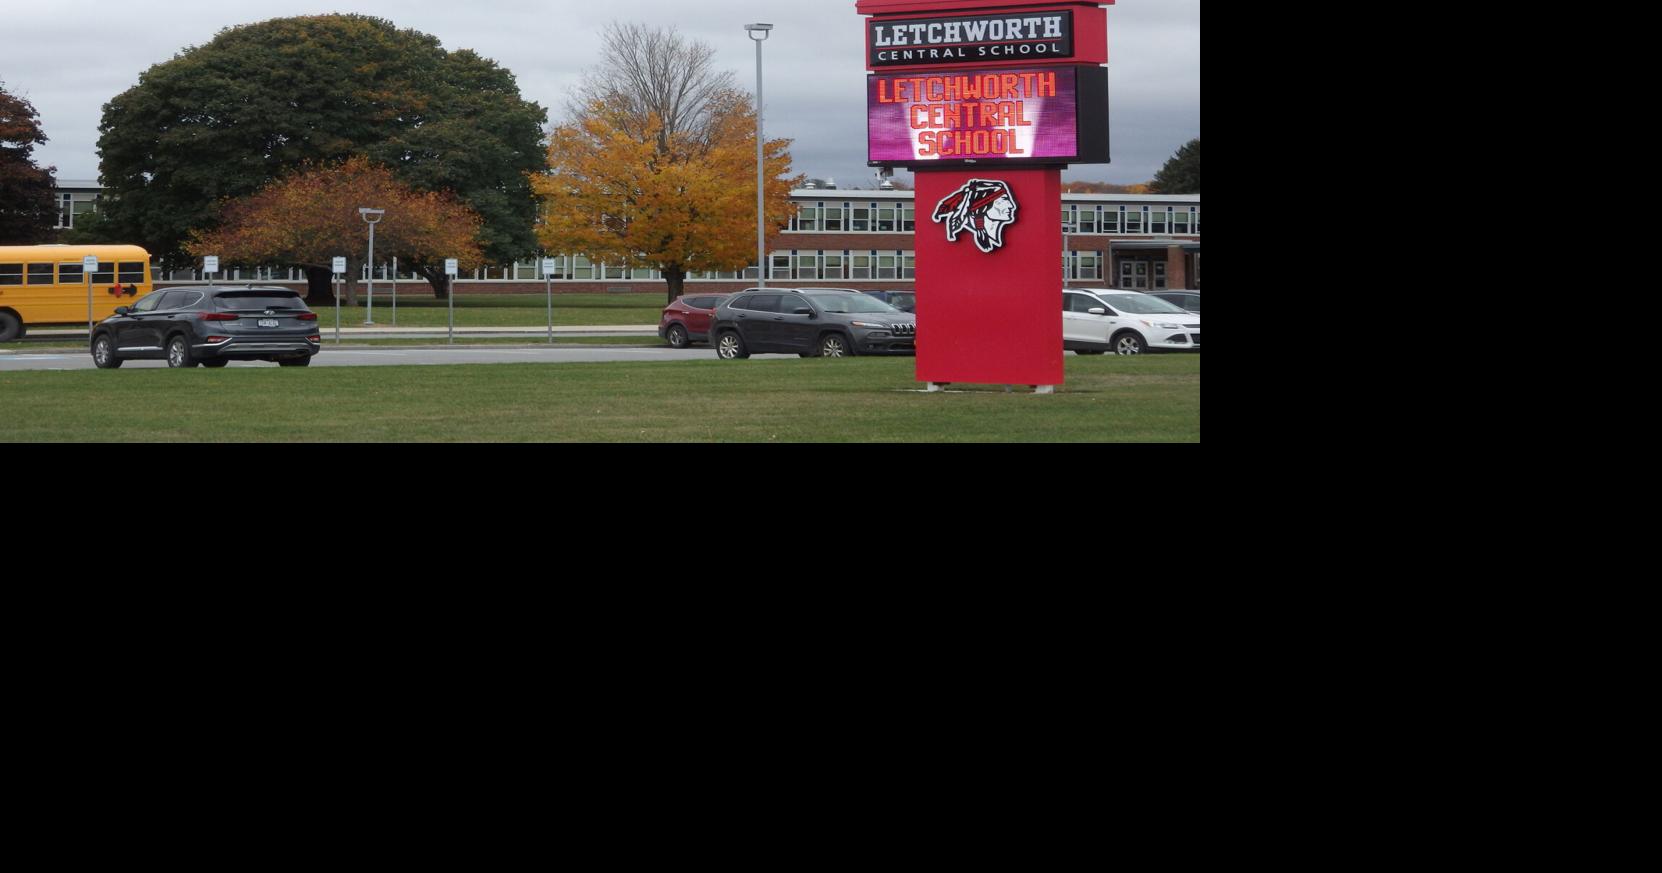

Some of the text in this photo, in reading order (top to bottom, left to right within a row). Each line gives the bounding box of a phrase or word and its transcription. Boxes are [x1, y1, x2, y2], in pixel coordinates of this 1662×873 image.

[875, 16, 1062, 46] LETCHWORTH
[878, 43, 1059, 61] CENTRAL SCHOOL
[878, 71, 1056, 103] LETCHWORTH
[910, 100, 1032, 129] CENTRAL
[918, 128, 1024, 156] SCHOOL
